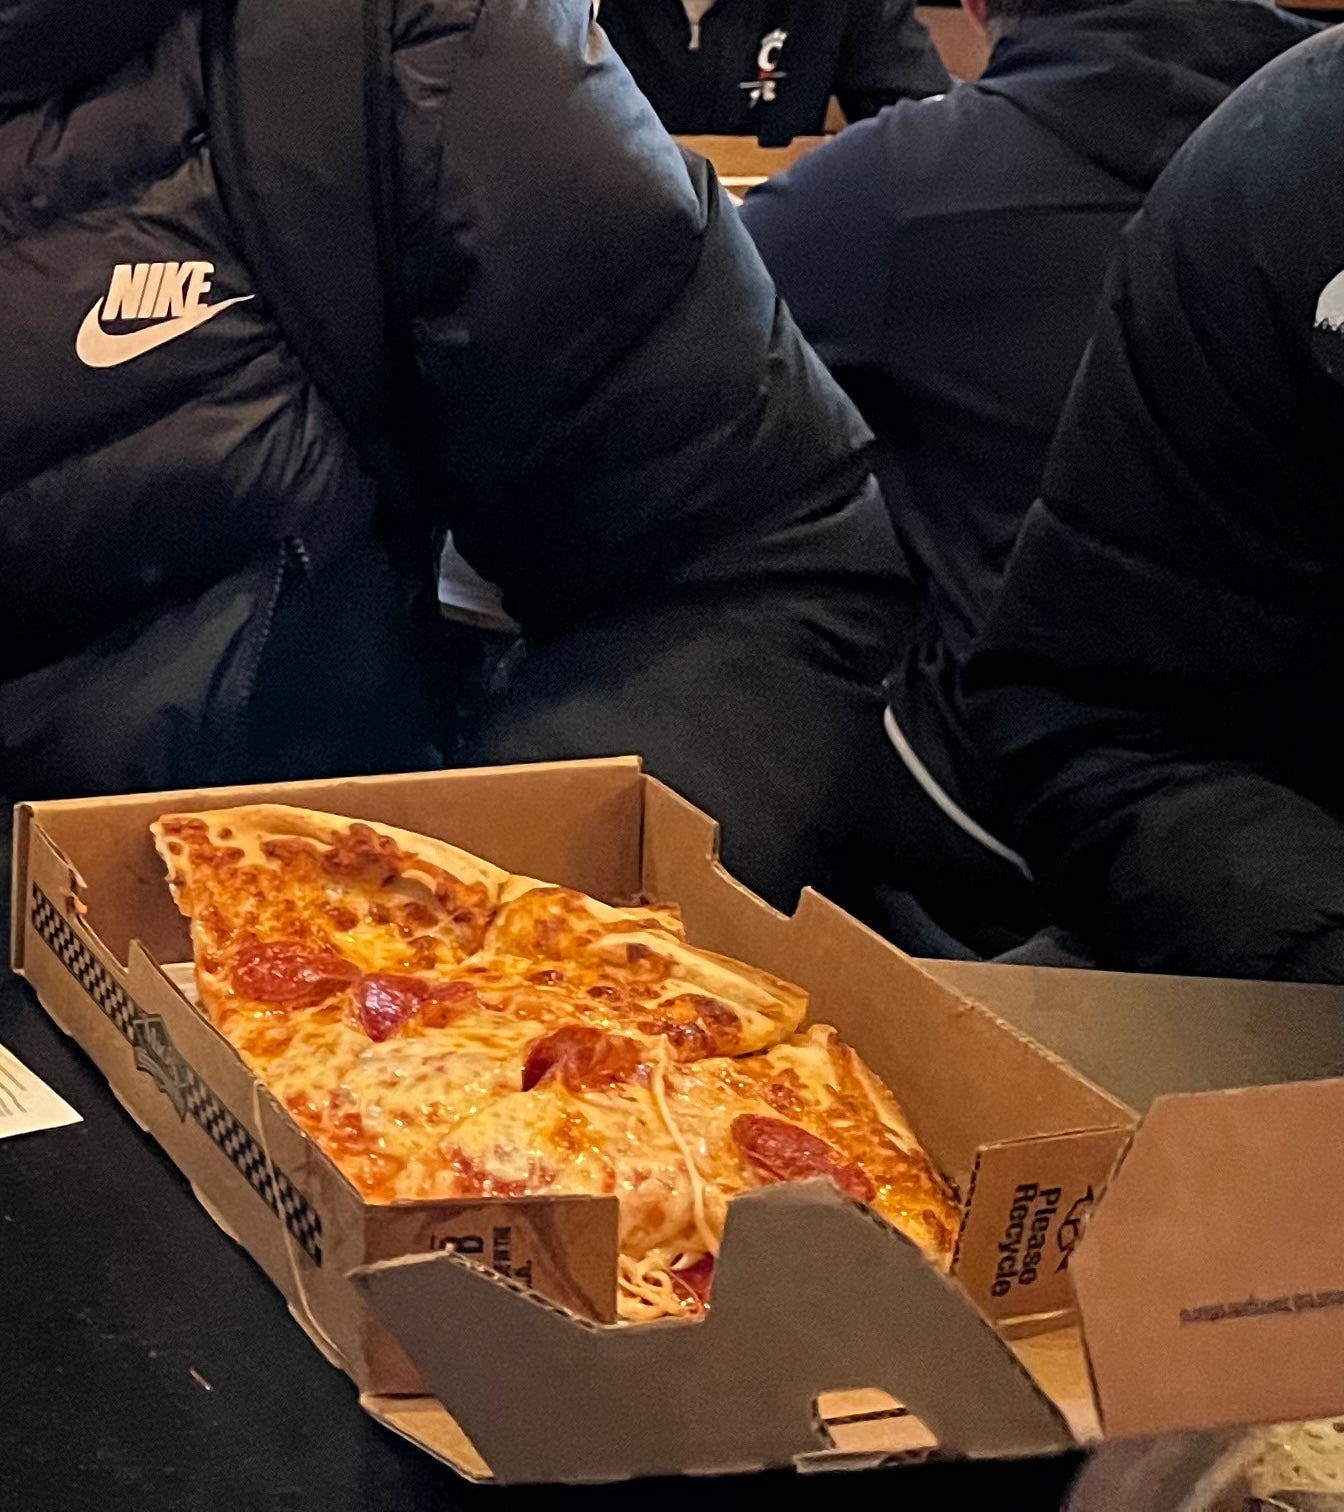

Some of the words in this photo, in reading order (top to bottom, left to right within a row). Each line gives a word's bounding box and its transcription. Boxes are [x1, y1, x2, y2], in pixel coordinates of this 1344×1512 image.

[102, 261, 214, 320] NIKE
[991, 1182, 1040, 1298] Recycle
[1018, 1185, 1062, 1287] Please
